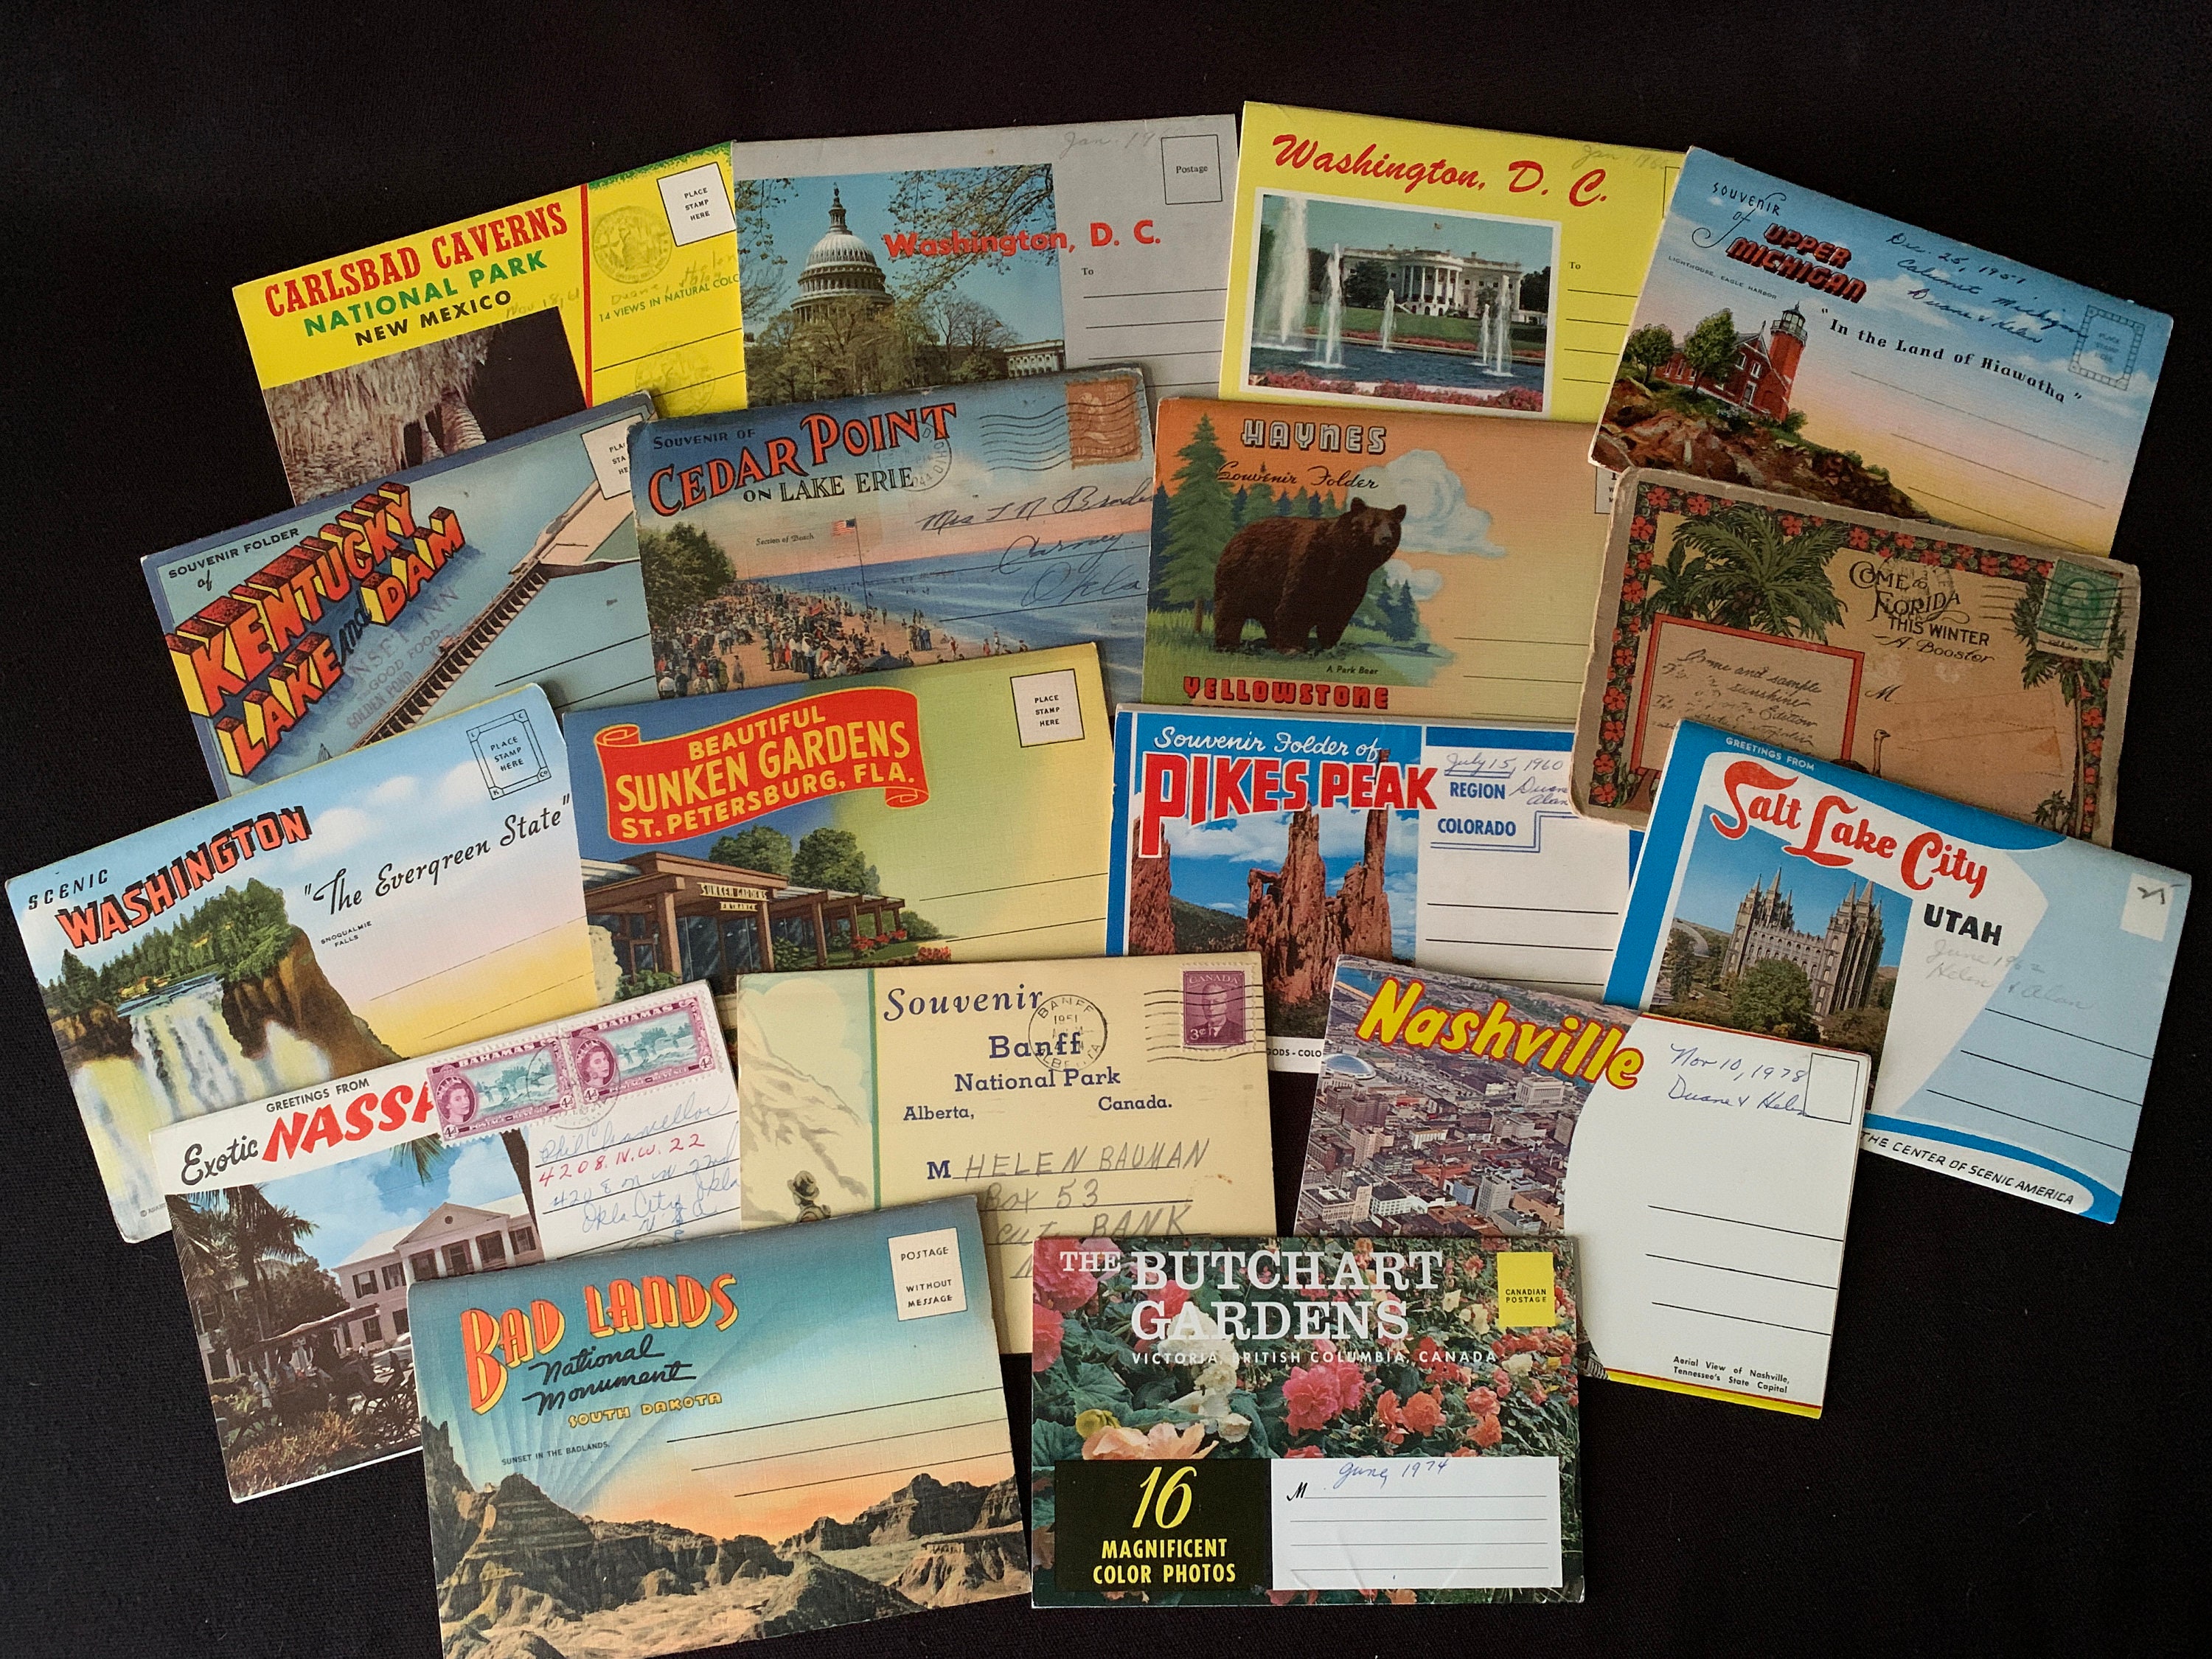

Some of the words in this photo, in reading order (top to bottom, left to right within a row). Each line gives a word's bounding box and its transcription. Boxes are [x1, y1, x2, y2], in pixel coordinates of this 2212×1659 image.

[1176, 164, 1208, 175] Postage
[1272, 133, 1486, 193] Washington,
[1507, 160, 1548, 196] D.
[1568, 167, 1607, 206] C.
[684, 187, 708, 198] PLACE
[685, 199, 709, 211] STAMP
[690, 211, 710, 221] HERE
[884, 229, 1076, 257] Washington,
[1090, 221, 1120, 247] D.
[1133, 220, 1161, 245] C.
[1764, 223, 1852, 270] UPPER
[265, 247, 421, 317] CARLSBAD
[431, 202, 567, 268] CAVERNS
[1082, 267, 1094, 276] To
[1569, 261, 1581, 271] To
[1725, 236, 1867, 304] MICHIGAN
[304, 276, 459, 337] NATIONAL
[471, 250, 548, 288] PARK
[1668, 255, 1715, 278] LIGHTHOUSE,
[1720, 276, 1744, 288] EAGLE
[1747, 286, 1777, 299] HARBOR
[599, 311, 611, 321] 14
[613, 302, 645, 317] VIEWS
[650, 298, 661, 307] IN
[664, 284, 709, 304] NATURAL
[712, 274, 740, 288] COLO
[355, 321, 410, 347] NEW
[420, 290, 512, 327] MEXICO
[1858, 324, 1887, 349] the
[1894, 338, 1944, 361] Land
[1953, 350, 1976, 367] of
[653, 432, 729, 451] SOUVENIR
[737, 428, 756, 439] OF
[1241, 418, 1387, 455] HAYNES
[648, 437, 800, 516] CEDAR
[799, 403, 957, 467] POINT
[1217, 460, 1298, 485] Souvenir
[1308, 464, 1380, 490] Folder
[742, 488, 772, 503] ON
[779, 477, 846, 503] LAKE
[856, 467, 914, 490] ERIE
[168, 546, 240, 579] SOUVENIR
[243, 526, 300, 556] FOLDER
[756, 538, 780, 546] Section
[790, 533, 814, 541] Beach
[197, 569, 214, 591] of
[166, 481, 417, 719] KENTUCKY
[1867, 589, 1970, 625] FLORIDA
[217, 632, 341, 777] LAKE
[338, 593, 372, 664] and
[361, 507, 466, 626] DAM
[1888, 616, 1924, 635] THIS
[1929, 624, 1990, 646] WINTER
[1917, 639, 1995, 664] Booster
[1336, 665, 1354, 674] Park
[1357, 667, 1379, 675] Bear
[1034, 694, 1060, 704] PLACE
[1183, 675, 1389, 709] YELLOWSTONE
[1035, 706, 1060, 716] STAMP
[1040, 717, 1060, 727] HERE
[490, 736, 518, 751] PLACE
[688, 705, 827, 761] BEAUTIFUL
[1153, 726, 1267, 753] Souvenir
[1273, 731, 1350, 758] Folder
[1354, 737, 1382, 762] of
[494, 747, 521, 762] STAMP
[500, 759, 524, 771] HERE
[616, 751, 748, 813] SUNKEN
[758, 720, 911, 780] GARDENS
[1523, 757, 1563, 771] 1960
[1725, 737, 1782, 761] GREETINGS
[1786, 754, 1815, 771] FROM
[621, 815, 663, 840] ST.
[667, 770, 846, 834] PETERSBURG,
[853, 762, 915, 785] FLA.
[1138, 752, 1312, 859] PIKES
[1320, 758, 1439, 812] PEAK
[1450, 782, 1506, 799] REGION
[1437, 817, 1517, 838] COLORADO
[1710, 760, 1803, 840] Salt
[1784, 793, 1897, 867] Lake
[1899, 832, 1987, 899] City
[55, 804, 313, 949] WASHINGTON
[375, 841, 493, 899] Evergreen
[28, 868, 110, 911] SCENIC
[321, 921, 372, 944] SNOQUALMIE
[335, 935, 358, 947] FALLS
[1923, 903, 2003, 947] UTAH
[1189, 974, 1239, 984] CANADA
[598, 1004, 673, 1030] BAHAMAS
[883, 982, 1046, 1022] Souvenir
[988, 1031, 1083, 1059] Banff
[1356, 976, 1646, 1090] Nashville
[459, 1043, 535, 1066] BAHAMAS
[265, 1088, 330, 1113] GREETINGS
[335, 1078, 369, 1094] FROM
[954, 1069, 1057, 1093] National
[1062, 1065, 1121, 1088] Park
[903, 1104, 975, 1122] Alberta,
[1098, 1093, 1172, 1113] Canada.
[181, 1135, 259, 1184] Exotic
[260, 1082, 434, 1163] NASS
[927, 1161, 951, 1179] M
[964, 1145, 1088, 1180] HELEN
[1860, 1132, 1889, 1147] THE
[1892, 1142, 1946, 1166] CENTER
[1949, 1160, 1967, 1171] OF
[1968, 1165, 2013, 1186] SCENIC
[2015, 1181, 2073, 1205] AMERICA
[1056, 1178, 1099, 1209] 53
[1091, 1205, 1192, 1237] BANK
[900, 1245, 948, 1262] POSTAGE
[905, 1278, 953, 1293] WITHOUT
[1060, 1252, 1121, 1273] THE
[1131, 1251, 1444, 1291] BUTCHART
[907, 1293, 953, 1307] MESSAGE
[1131, 1301, 1409, 1341] GARDENS
[460, 1297, 566, 1416] BAD
[582, 1272, 737, 1341] LANDS
[528, 1335, 665, 1385] National
[1133, 1352, 1223, 1366] VICTORIA,
[1233, 1352, 1301, 1364] BRITISH
[1310, 1352, 1411, 1365] COLUMBIA,
[1418, 1351, 1498, 1364] CANADA
[1673, 1356, 1699, 1366] Aerial
[1705, 1361, 1726, 1371] View
[1750, 1369, 1790, 1384] Nashville,
[1674, 1366, 1720, 1381] Tennessee's
[1728, 1377, 1749, 1386] State
[1757, 1382, 1787, 1393] Capital
[522, 1361, 697, 1417] Monument
[568, 1406, 630, 1429] SOUTH
[641, 1391, 723, 1416] DAKOTA
[501, 1454, 532, 1466] SUNSET
[546, 1449, 563, 1457] THE
[1132, 1466, 1197, 1529] 16
[1102, 1538, 1228, 1559] MAGNIFICENT
[1093, 1565, 1151, 1585] COLOR
[1164, 1564, 1236, 1584] PHOTOS
